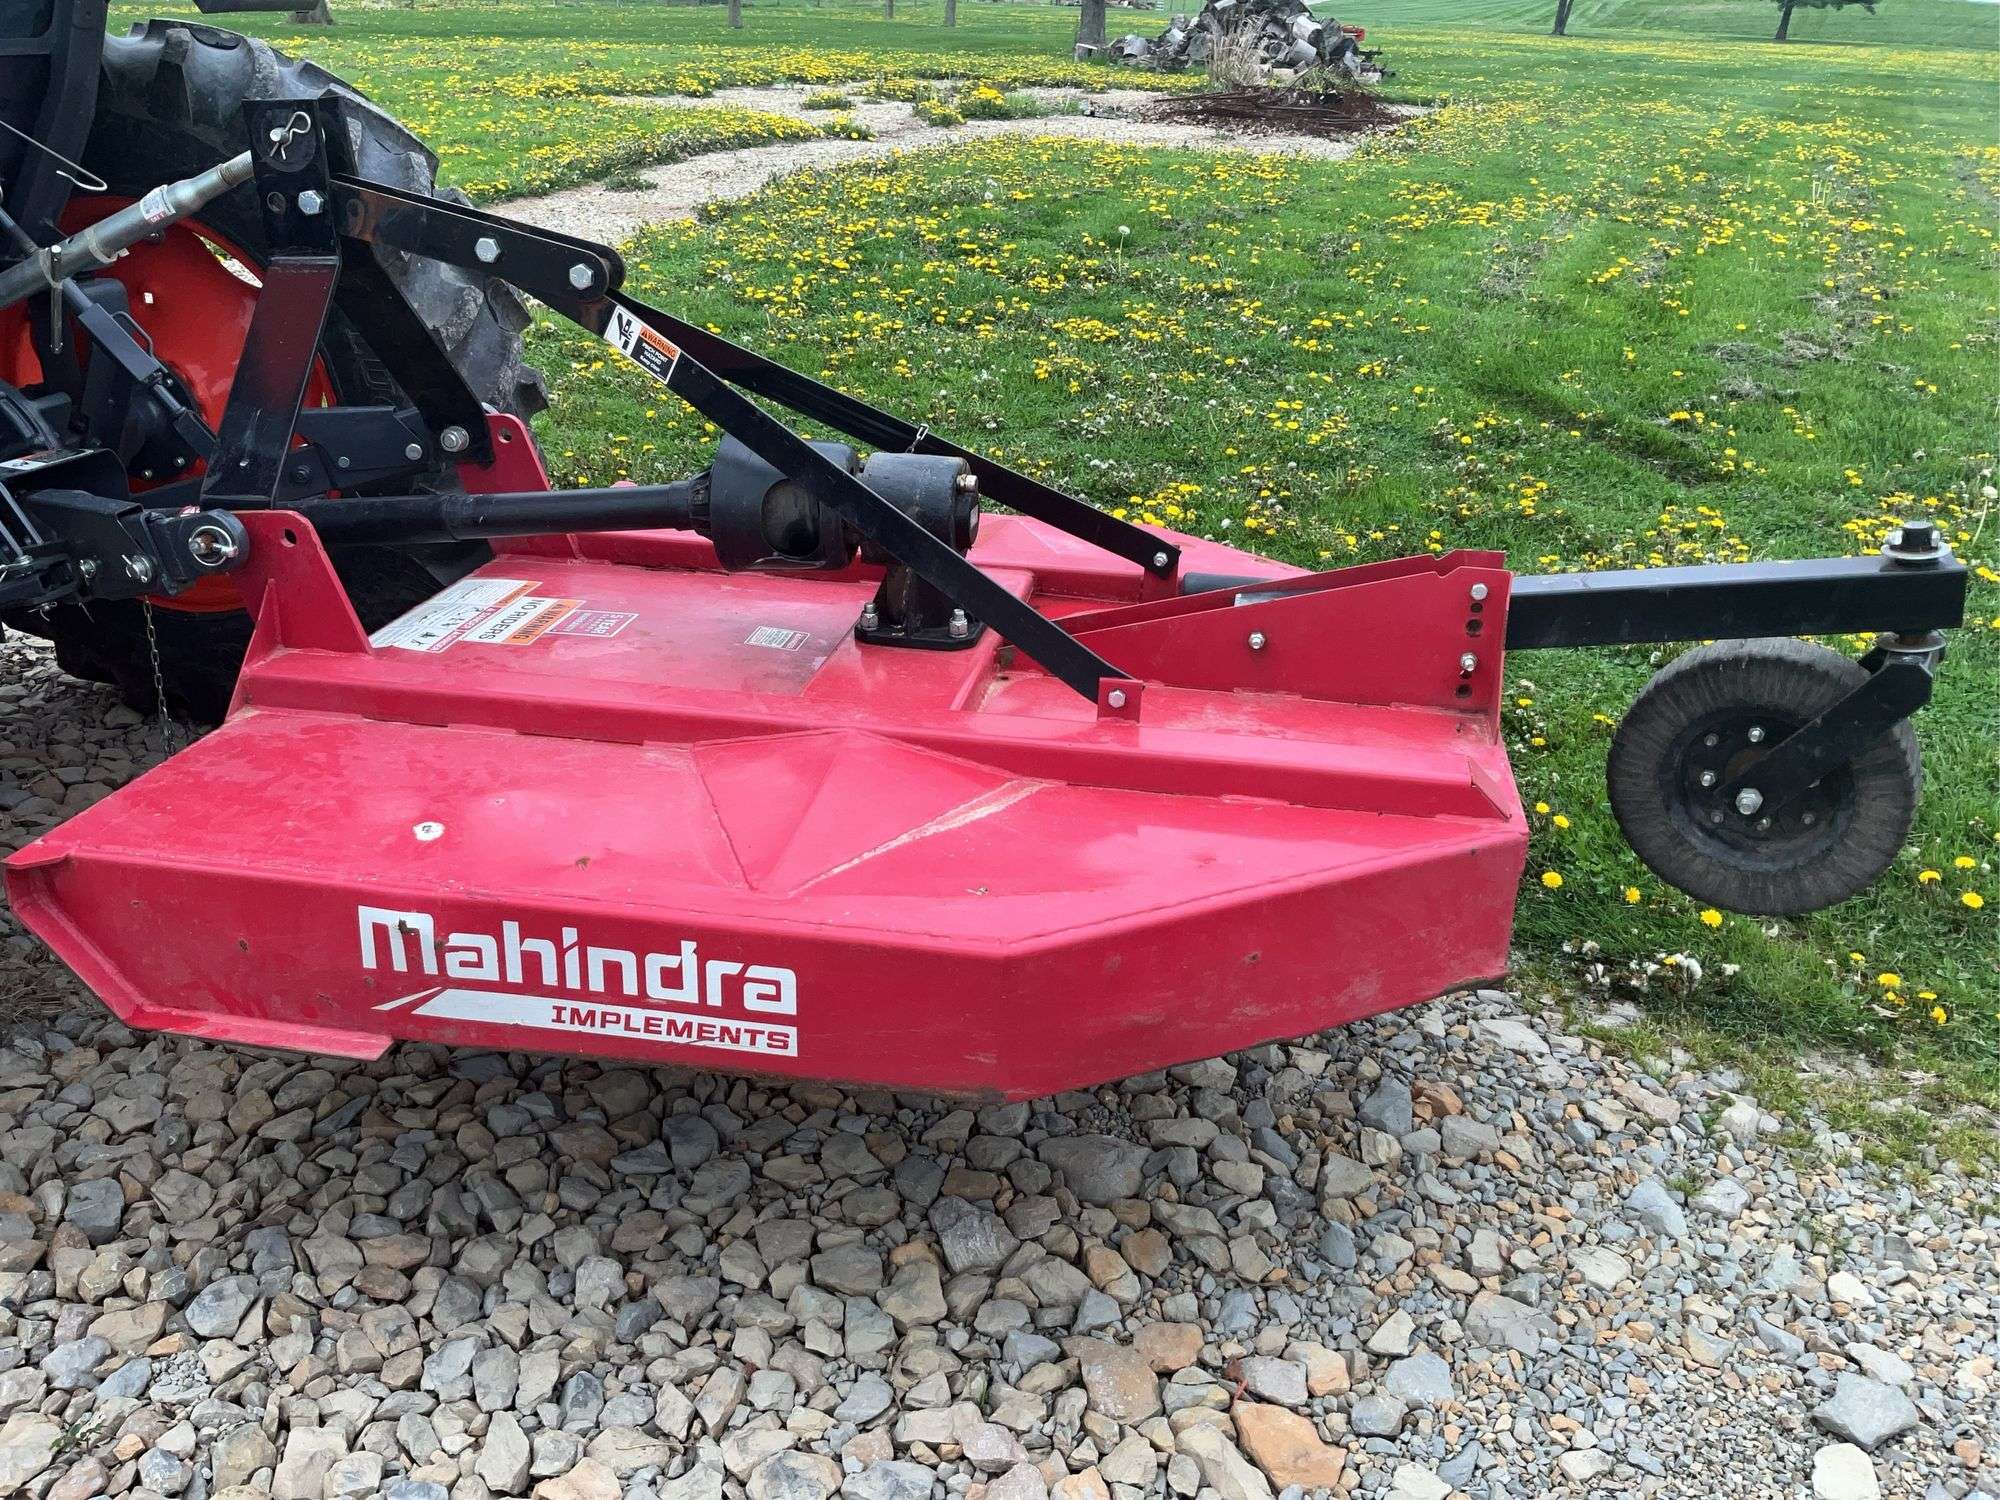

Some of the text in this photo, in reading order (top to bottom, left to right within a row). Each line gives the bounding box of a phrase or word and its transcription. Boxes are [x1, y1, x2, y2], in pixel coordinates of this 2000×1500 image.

[647, 333, 676, 357] WARNING
[479, 600, 545, 639] NO RIDERS
[512, 609, 561, 640] WARNING
[358, 905, 797, 1015] Mahindra
[551, 1005, 790, 1050] IMPLEMENTS
